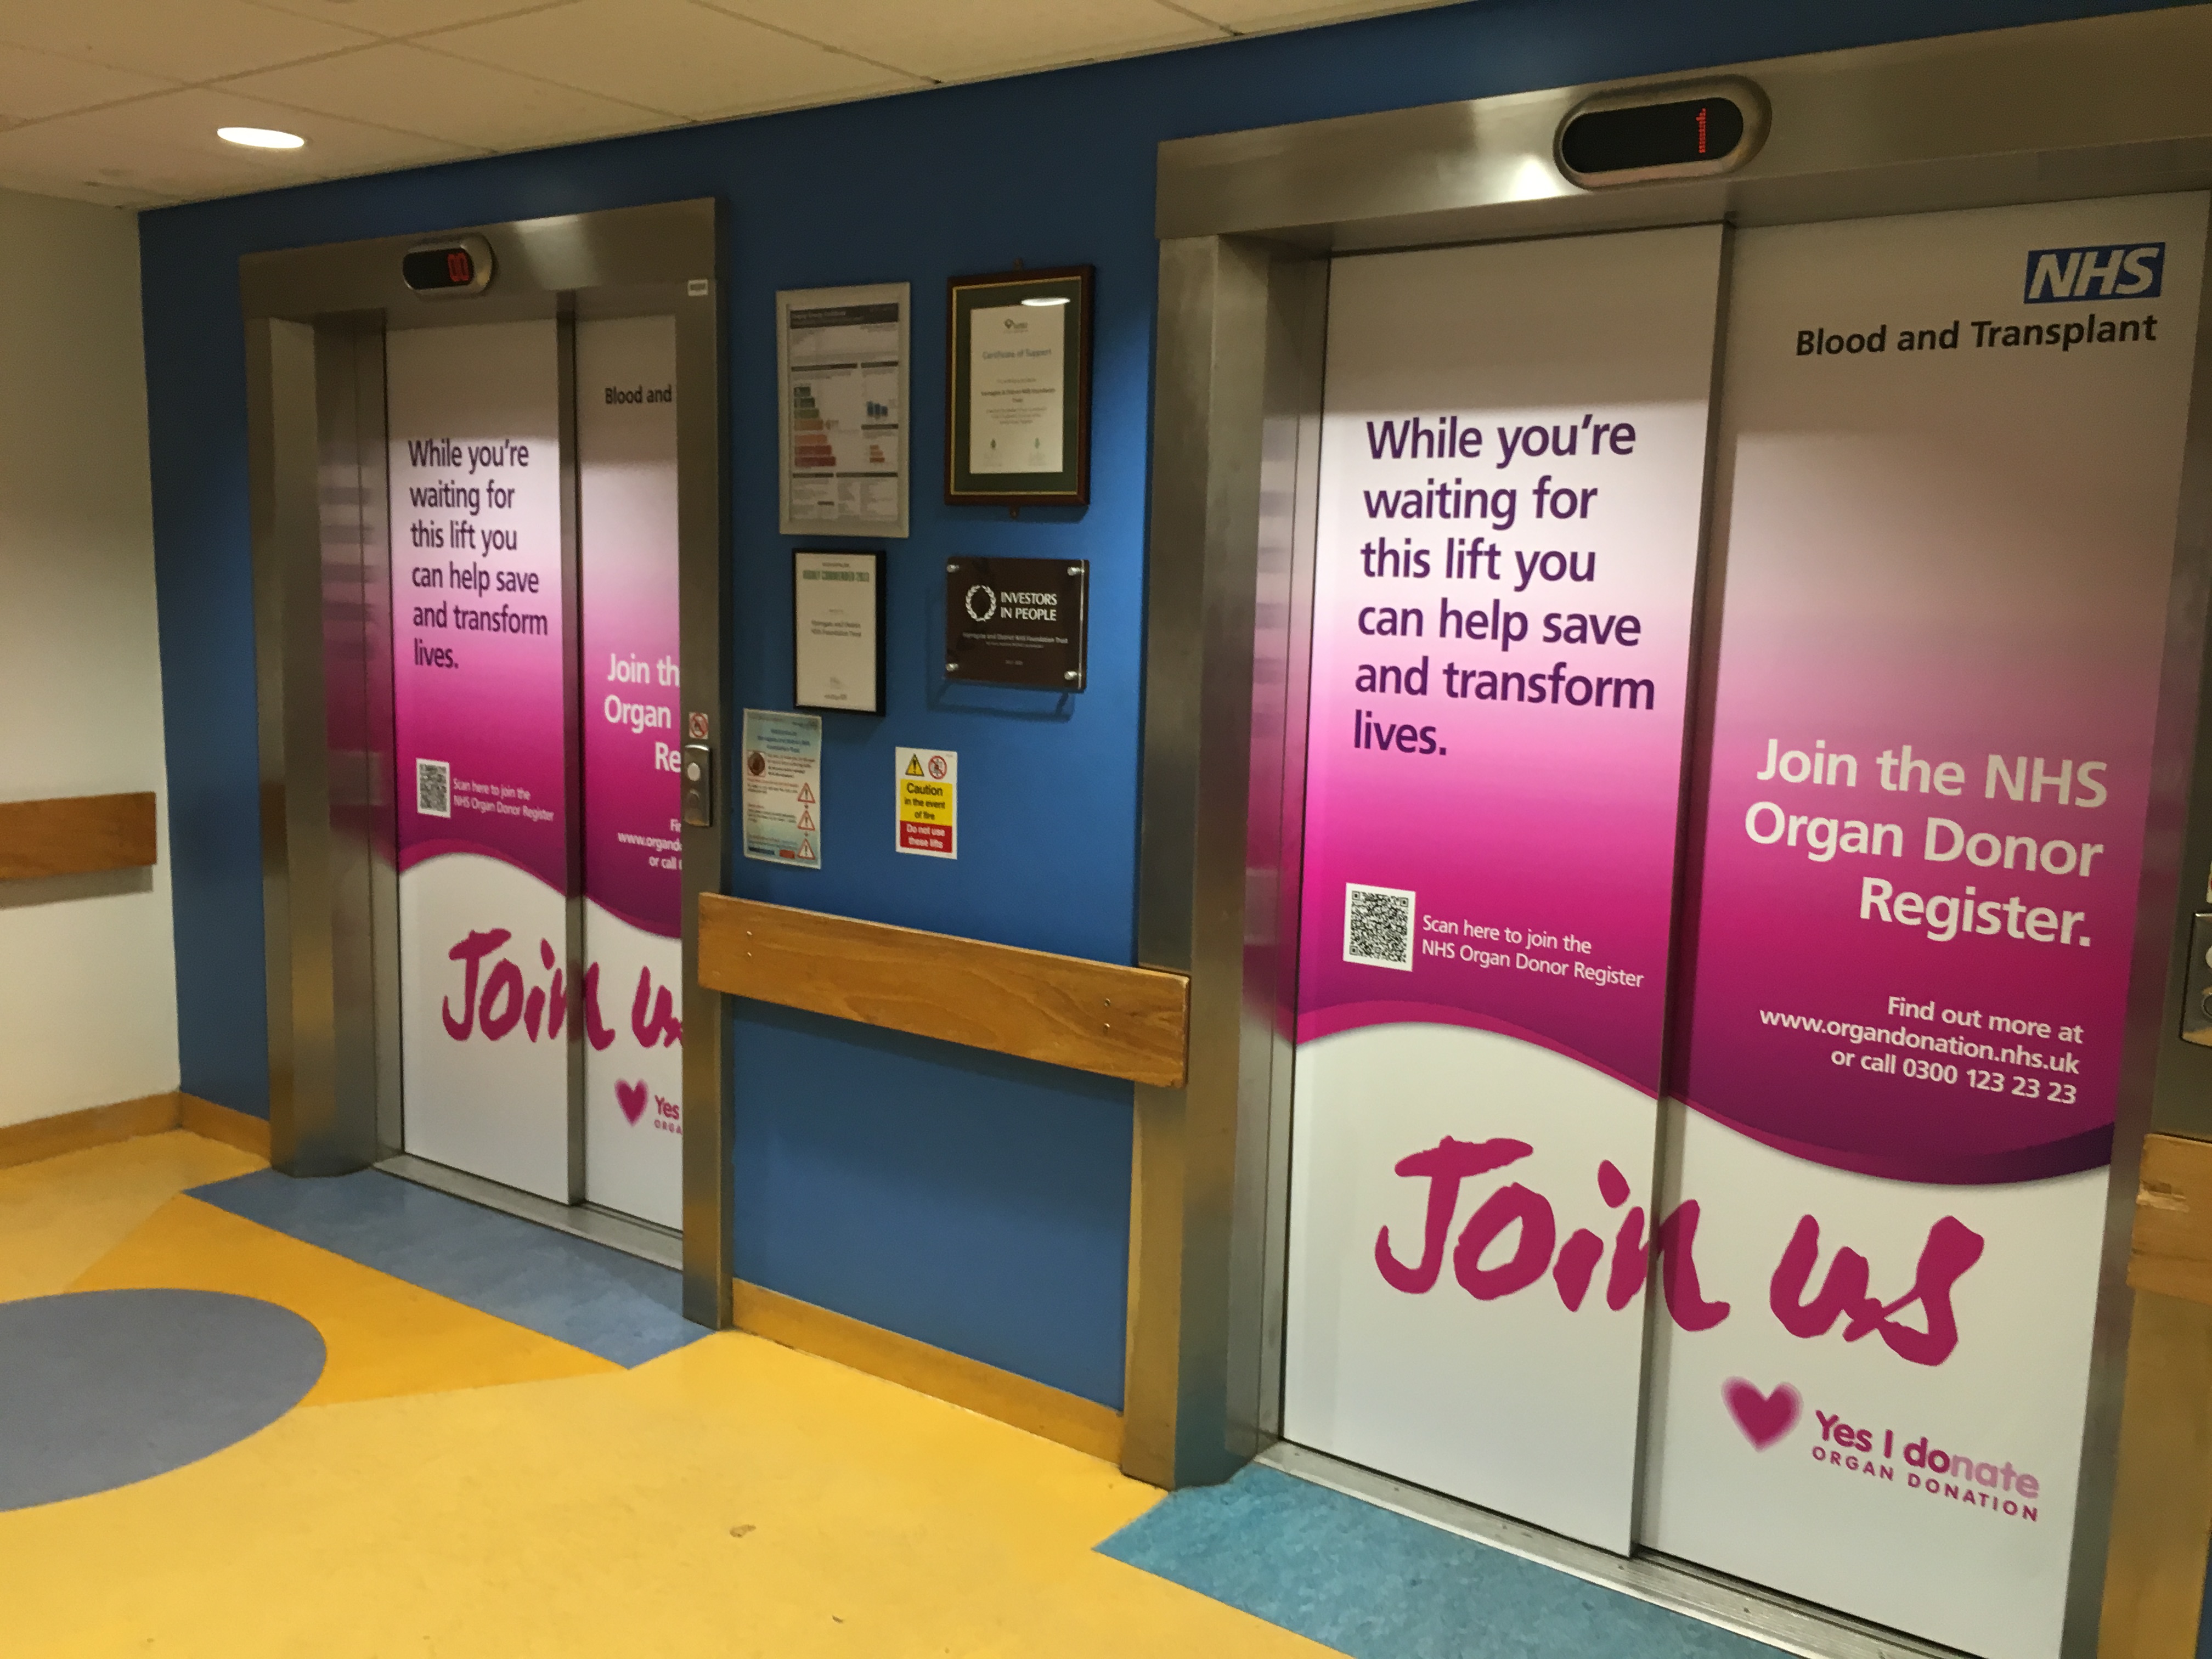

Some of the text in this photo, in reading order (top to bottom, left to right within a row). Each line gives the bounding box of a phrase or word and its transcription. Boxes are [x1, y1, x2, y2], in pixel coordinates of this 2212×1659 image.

[1696, 108, 1706, 153] 1
[2029, 247, 2159, 300] NHS
[1796, 314, 2157, 356] Blood and Transplant
[605, 384, 672, 404] Blood and
[408, 438, 529, 475] While you're
[1366, 414, 1635, 469] While you're
[409, 479, 515, 516] waiting for
[1363, 475, 1598, 531] waiting for
[410, 519, 517, 557] this lift you
[412, 561, 539, 597] can help save
[1361, 537, 1596, 592] this lift you
[413, 601, 548, 636] and transform
[1001, 591, 1057, 606] INVESTORS
[1001, 607, 1057, 621] IN PEOPLE
[1358, 597, 1641, 652] can help save
[414, 637, 459, 669] lives.
[607, 652, 650, 685] Join
[1355, 656, 1655, 710] and transform
[604, 694, 671, 734] Organ
[1354, 709, 1447, 756] lives.
[490, 785, 499, 796] to
[907, 782, 943, 796] Caution
[1757, 738, 2107, 808] Join the NHS
[453, 795, 470, 808] NHS
[471, 797, 495, 814] Organ
[496, 801, 521, 816] Donor
[906, 823, 917, 833] Do
[918, 826, 930, 835] not
[1745, 801, 2104, 877] Organ Donor
[649, 856, 659, 867] or
[661, 856, 677, 870] call
[1860, 876, 2091, 947] Register.
[1423, 915, 1592, 954] Scan here to join the
[1423, 939, 1644, 988] NHS Organ Donor Register
[442, 928, 616, 1051] Join
[1759, 1009, 2080, 1074] www.organdonation.nhs.uk
[1888, 996, 2084, 1044] Find out more at
[1831, 1050, 2076, 1105] or call 0300 123 23 23
[654, 1094, 680, 1120] Yes
[1375, 1135, 1985, 1367] Join us
[1815, 1409, 2040, 1499] Yes I donate
[1812, 1446, 2038, 1522] ORGAN DONATION
